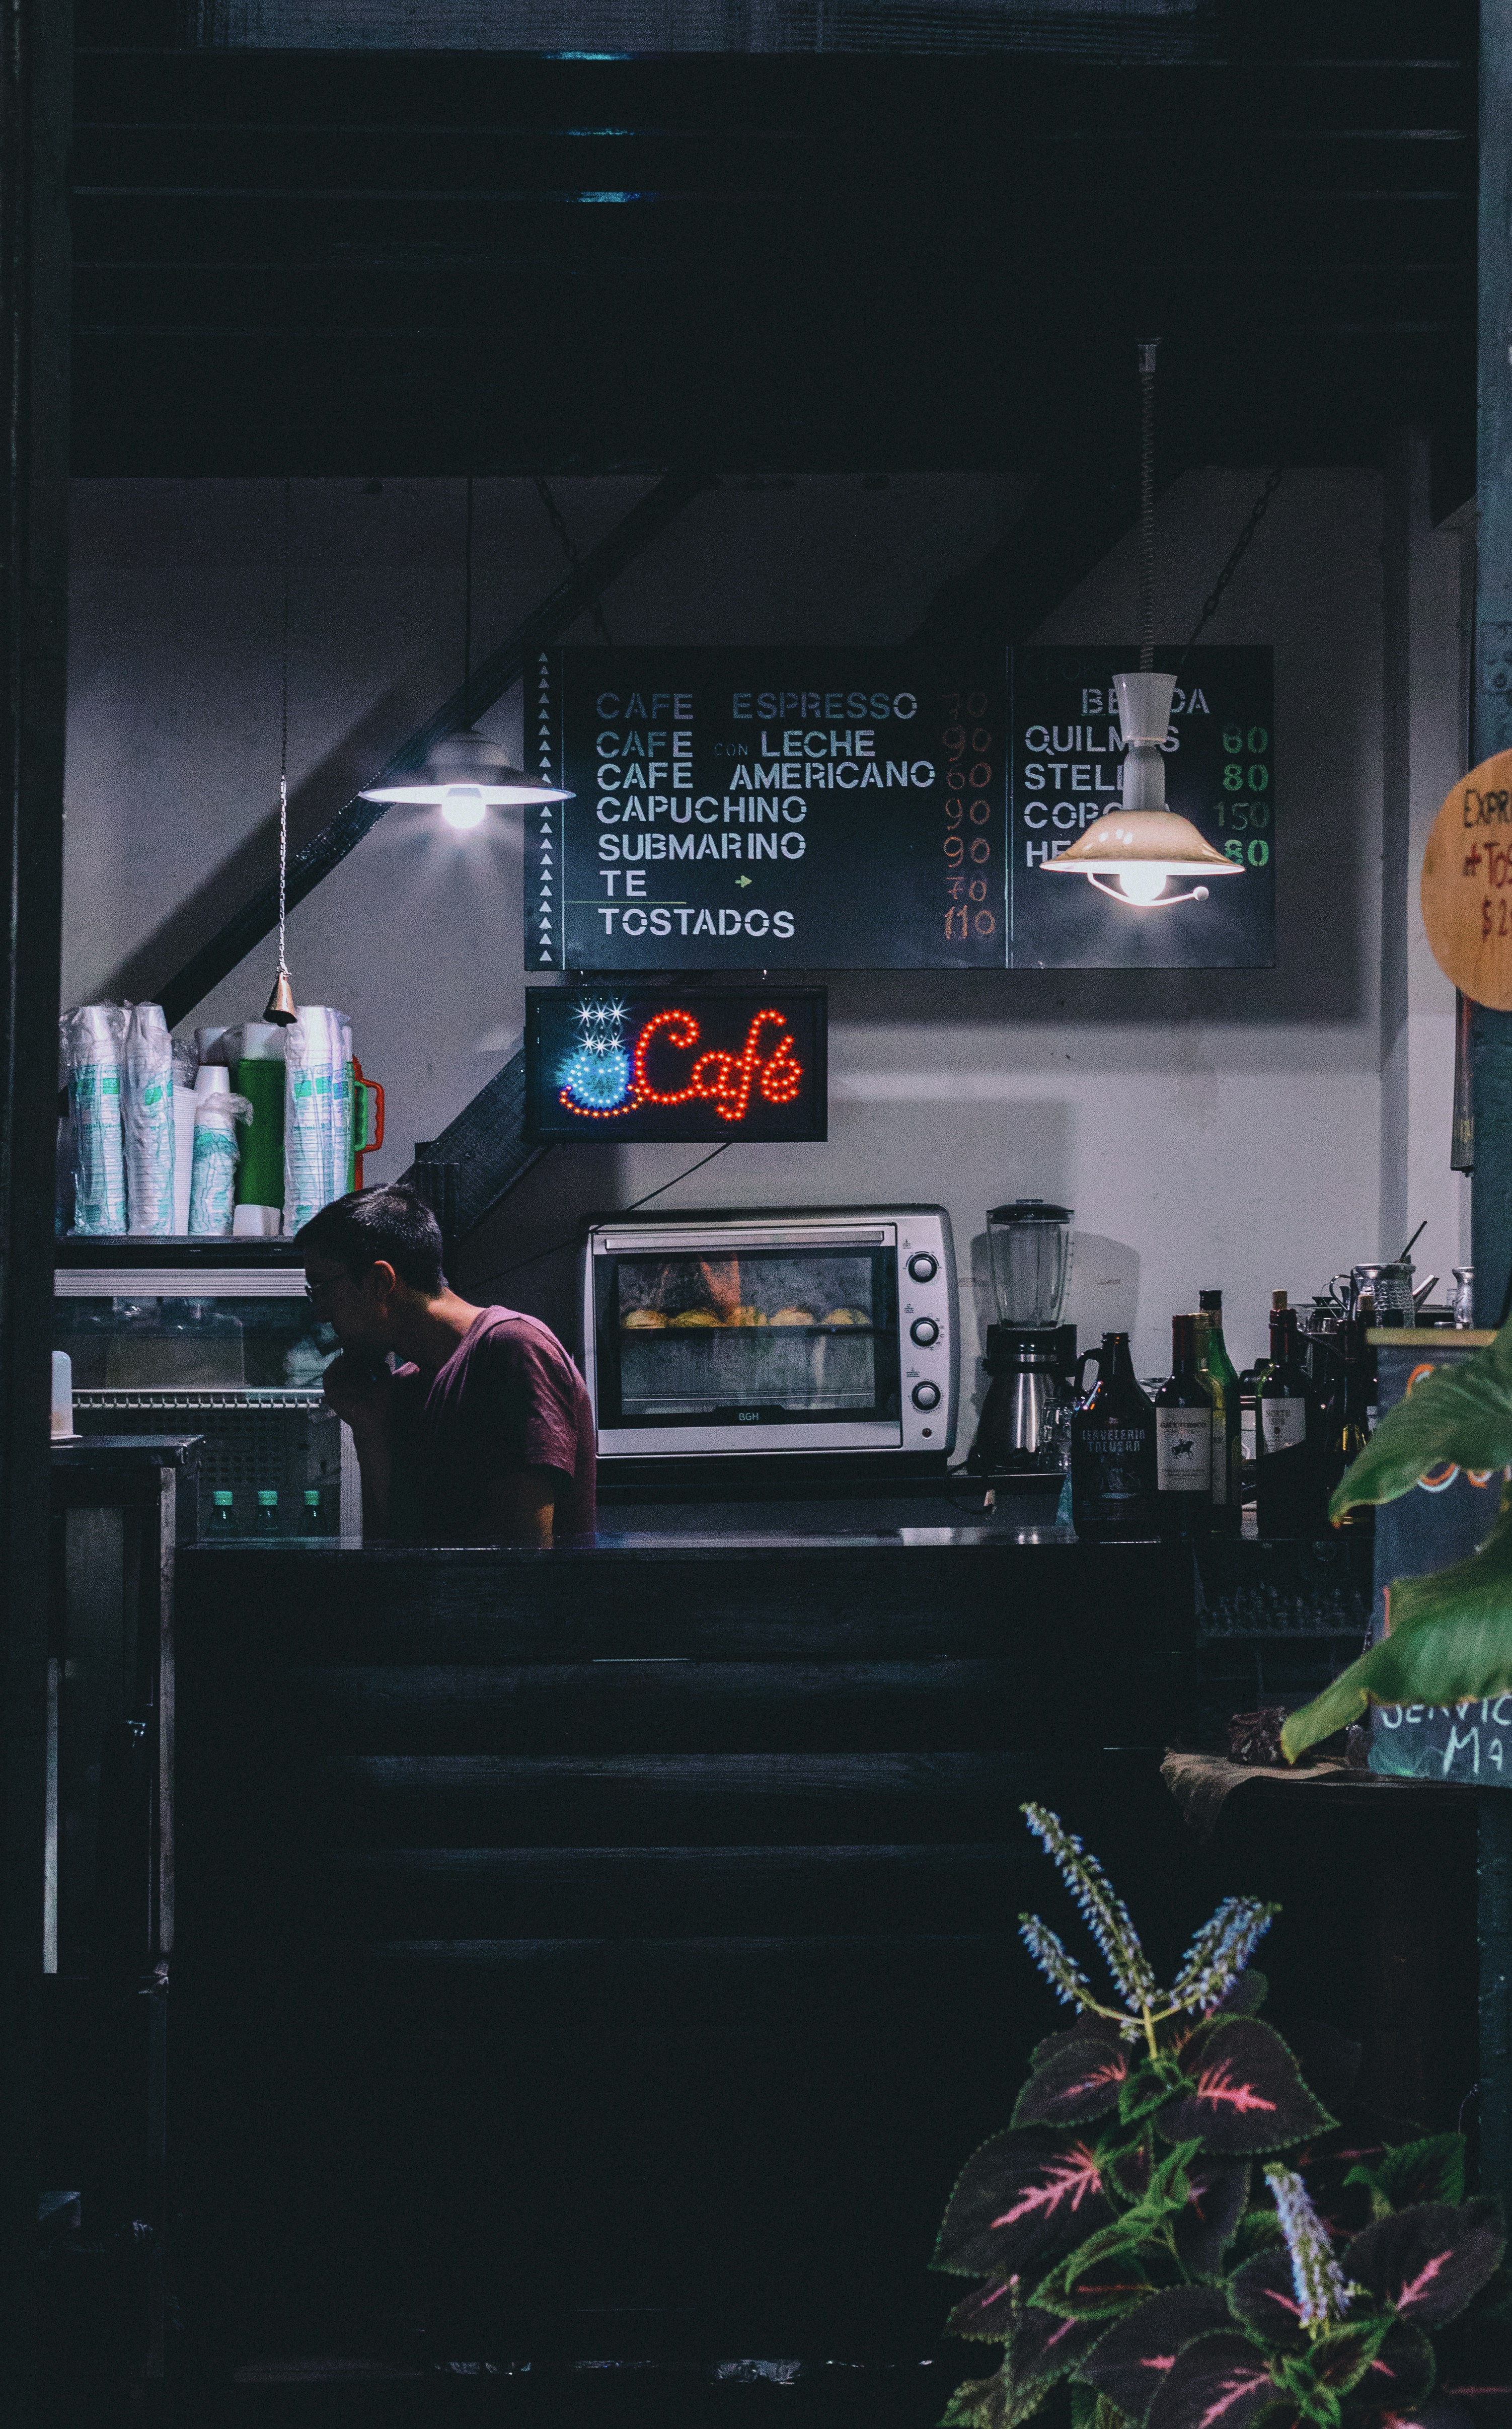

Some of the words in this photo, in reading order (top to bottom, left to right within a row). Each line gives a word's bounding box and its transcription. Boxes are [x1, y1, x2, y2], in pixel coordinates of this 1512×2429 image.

[596, 693, 693, 719] CAFE
[733, 692, 917, 719] ESPRESSO
[596, 731, 693, 757] CAFE
[714, 743, 748, 756] CON
[762, 730, 876, 757] LECHE
[942, 726, 992, 762] 90
[1025, 725, 1180, 755] QUILMS
[597, 762, 693, 790] CAFE
[730, 761, 935, 790] AMERICANO
[947, 762, 992, 789] 60
[1223, 763, 1269, 792] 80
[596, 795, 807, 824] CAPUCHINO
[945, 798, 991, 831] 90
[1213, 801, 1270, 830] 150
[598, 832, 806, 861] SUBMARINO
[943, 836, 990, 868] 90
[1225, 839, 1269, 867] 80
[599, 870, 647, 897] TE
[946, 876, 987, 902] 70
[598, 908, 795, 938] TOSTADOS
[944, 905, 996, 940] 110
[634, 1009, 802, 1122] Café
[739, 1413, 759, 1421] BGH
